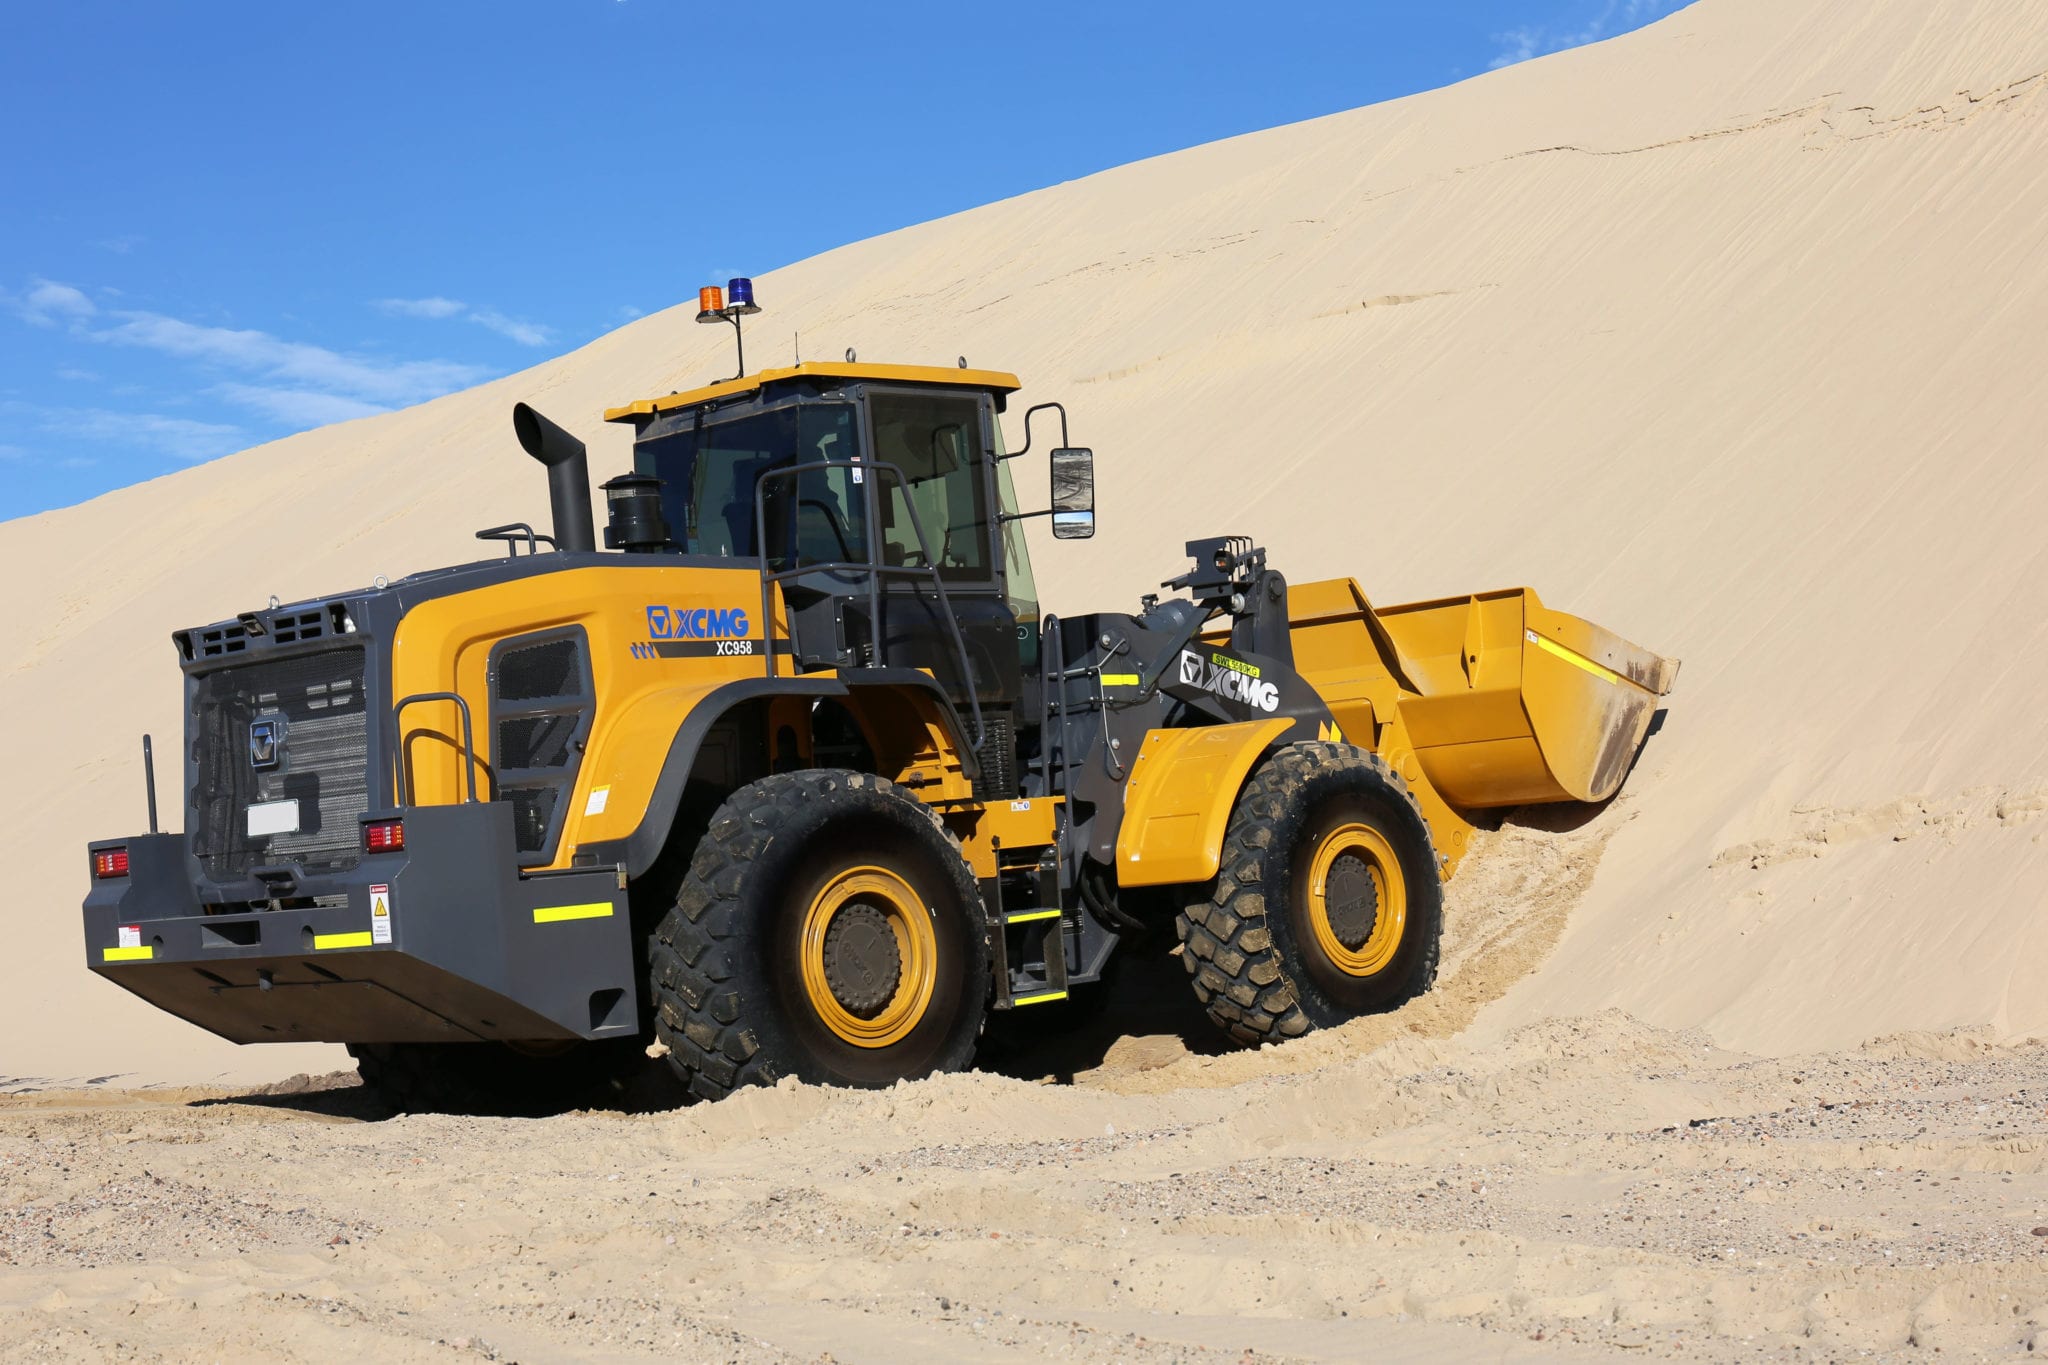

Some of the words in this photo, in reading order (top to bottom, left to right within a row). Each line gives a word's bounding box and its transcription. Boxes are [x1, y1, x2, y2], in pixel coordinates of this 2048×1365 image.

[673, 608, 749, 639] XCMG
[716, 641, 752, 655] XC958
[1202, 662, 1280, 712] XCMG
